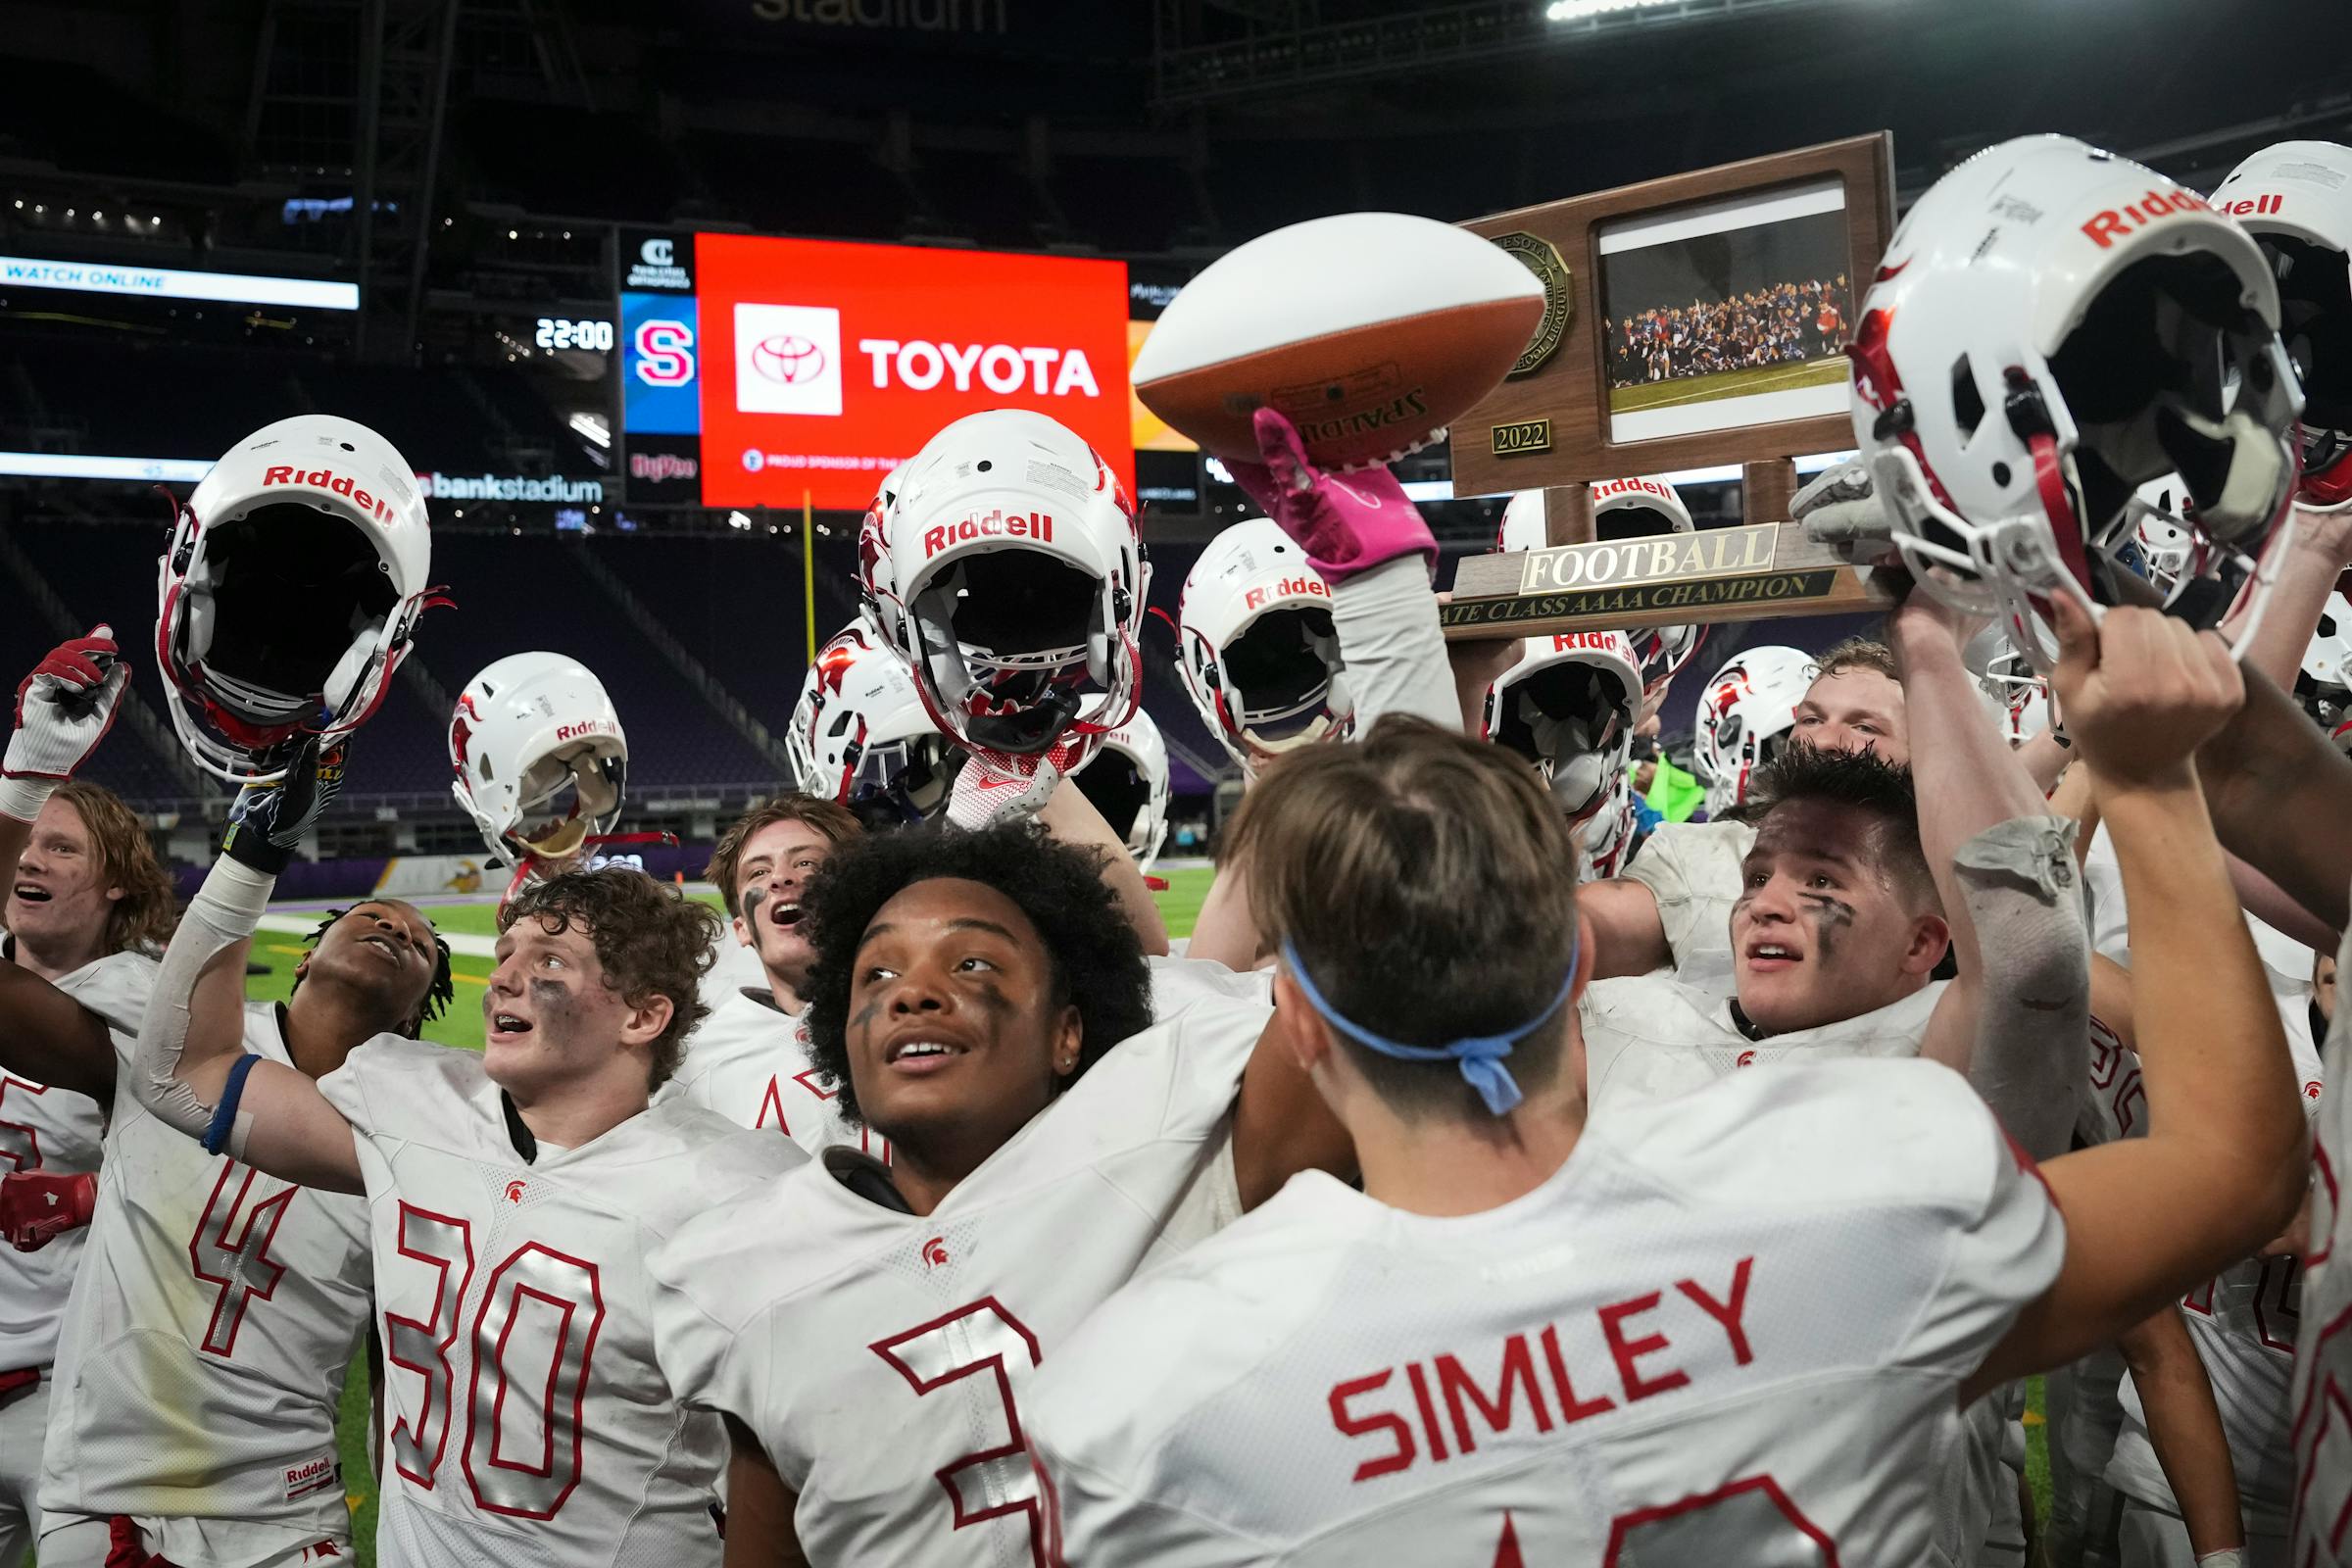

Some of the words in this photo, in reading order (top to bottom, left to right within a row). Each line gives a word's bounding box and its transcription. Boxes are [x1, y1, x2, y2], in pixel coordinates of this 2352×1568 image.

[7, 266, 81, 282] WATCH
[89, 271, 165, 289] ONLINE
[536, 318, 613, 351] 22:00
[1545, 282, 1568, 343] LEAGUE
[635, 319, 695, 387] S
[858, 339, 1101, 397] TOYOTA
[1299, 387, 1428, 443] SPALDI
[1495, 424, 1545, 450] 2022
[263, 466, 395, 526] Riddell
[924, 510, 1053, 560] Riddell
[1527, 530, 1772, 589] FOOTBALL
[1441, 604, 1484, 624] ATE
[1487, 596, 1568, 620] CLASS
[1570, 593, 1644, 613] AAAA
[1651, 575, 1811, 607] CHAMPION
[190, 1158, 301, 1358] 4
[384, 1198, 606, 1521] 30
[1328, 1255, 1755, 1483] SIMLEY
[287, 1456, 331, 1484] Riddell
